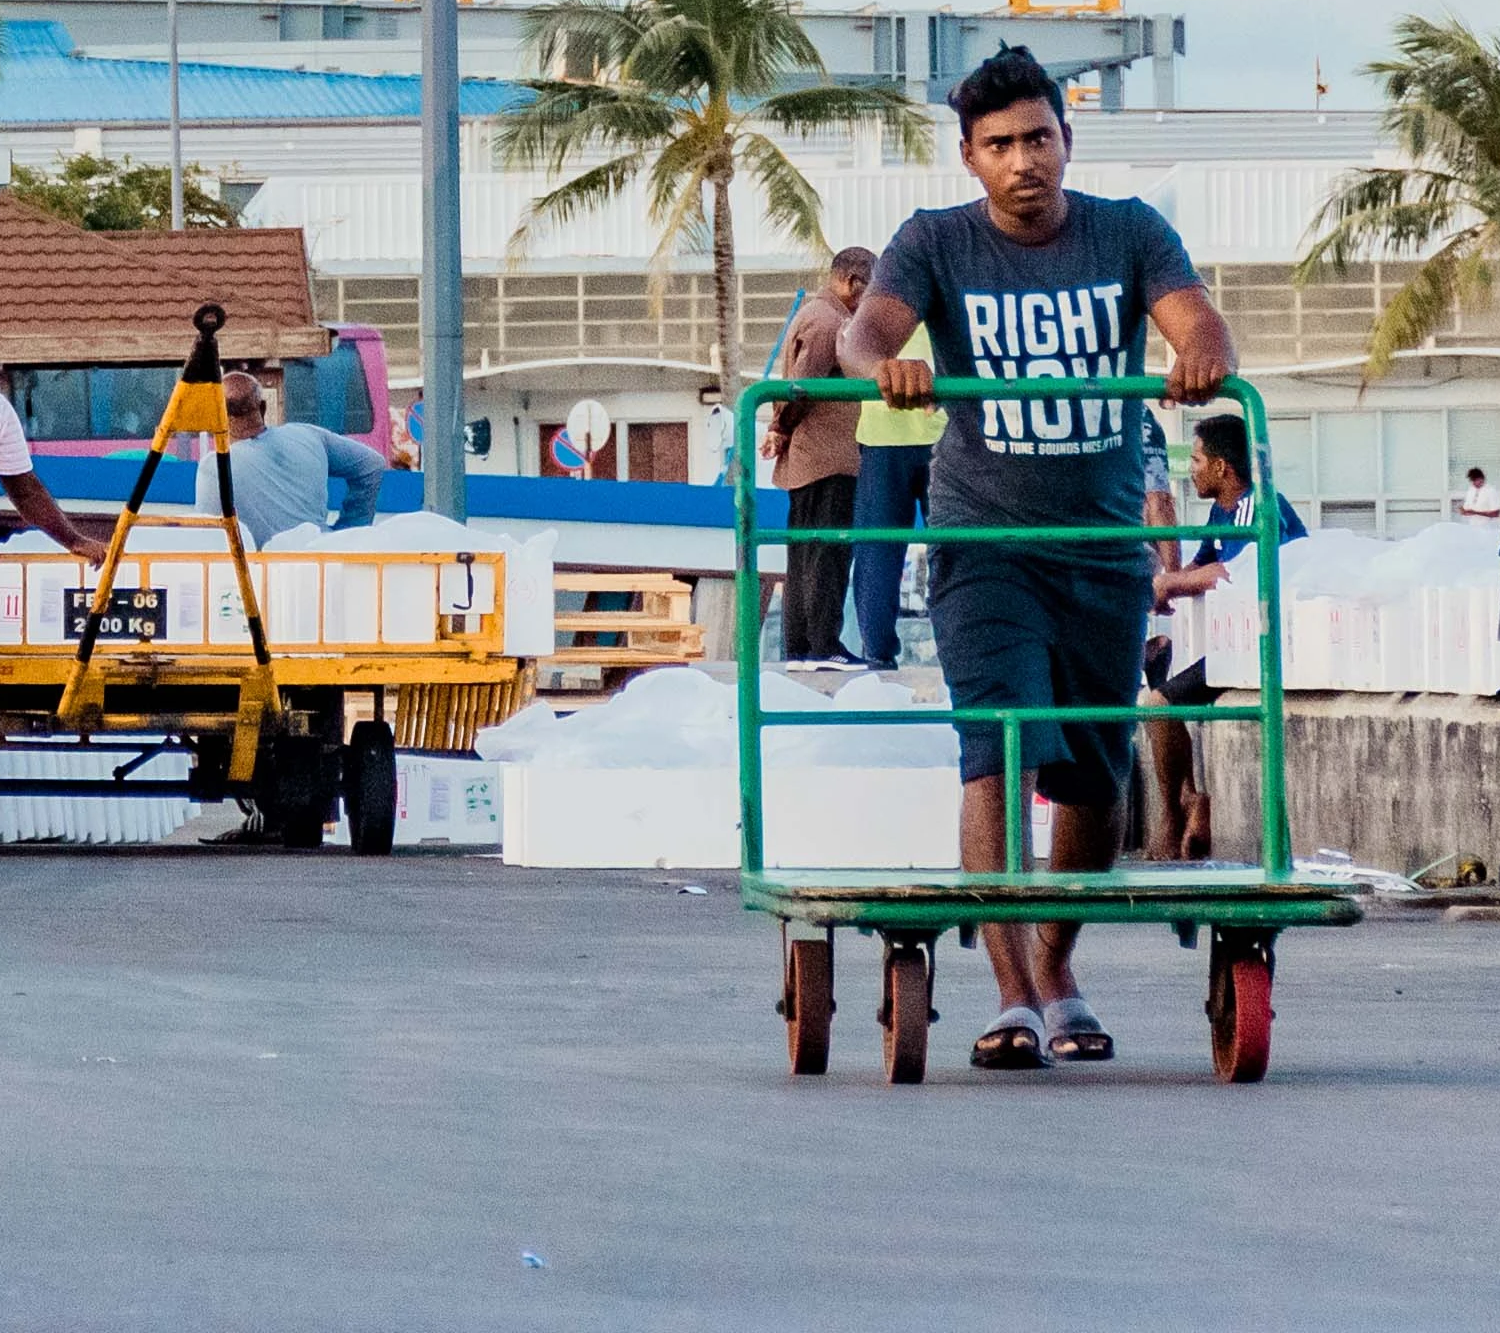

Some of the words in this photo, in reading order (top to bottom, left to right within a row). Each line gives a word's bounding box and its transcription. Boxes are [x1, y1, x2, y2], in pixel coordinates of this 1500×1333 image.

[964, 284, 1123, 357] RIGHT
[975, 351, 1127, 439] NOW
[133, 593, 158, 608] 06
[74, 617, 122, 633] 200
[128, 617, 156, 636] Kg
